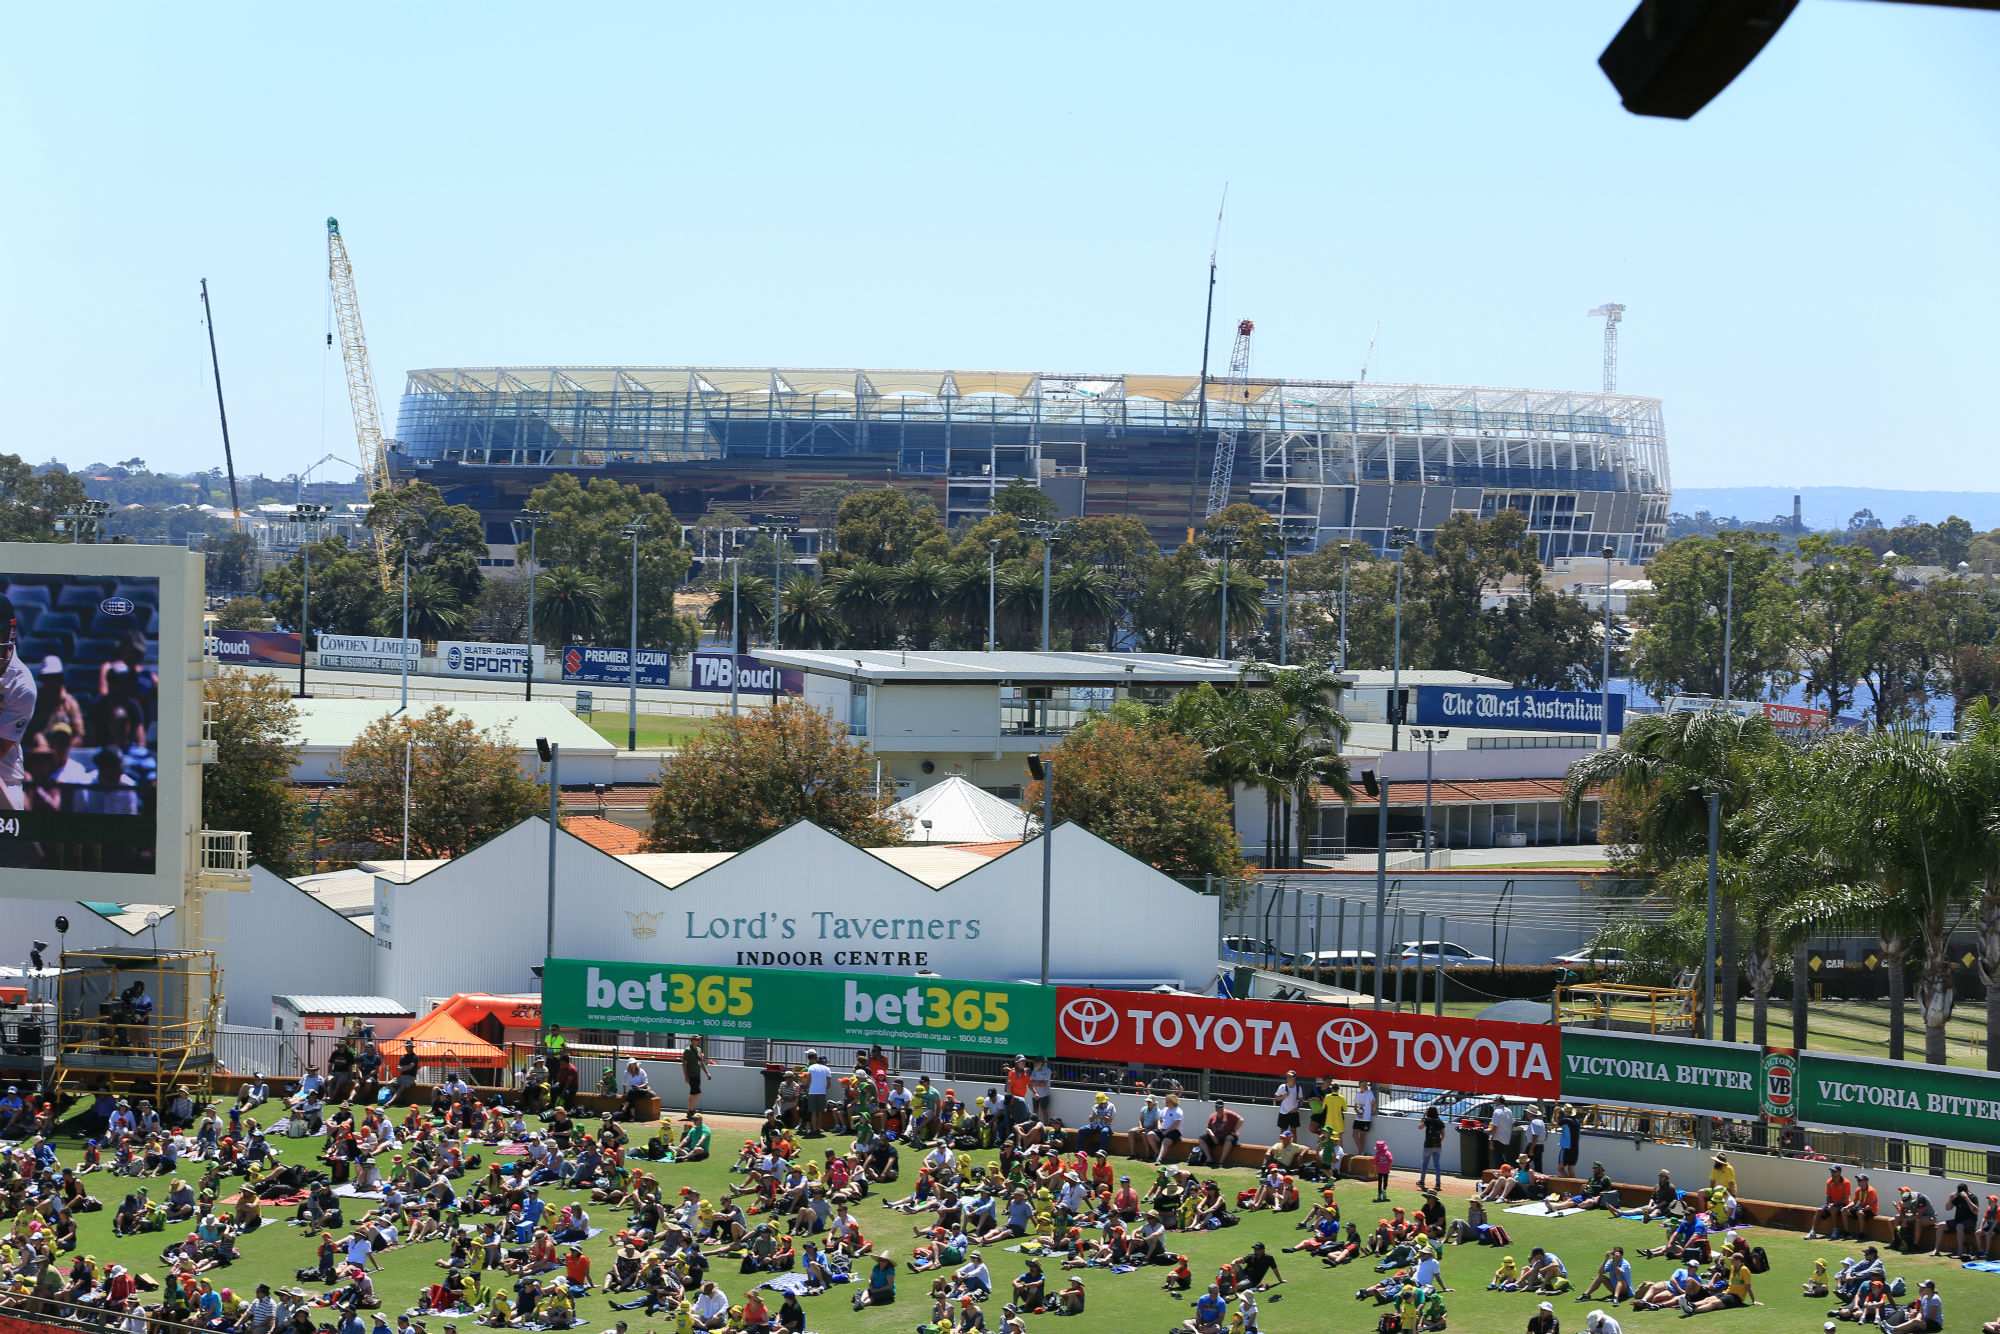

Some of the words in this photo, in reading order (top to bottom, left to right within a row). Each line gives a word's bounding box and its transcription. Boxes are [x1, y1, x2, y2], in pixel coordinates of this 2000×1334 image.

[320, 636, 368, 651] COWDEN
[585, 650, 628, 663] PREMIER
[633, 652, 668, 666] UZUKI
[464, 657, 533, 674] SPORTS
[695, 657, 781, 689] TABtouch
[1442, 692, 1473, 715] The
[1476, 693, 1521, 718] West
[1522, 695, 1604, 721] Australian
[686, 911, 796, 940] Lord's
[811, 911, 981, 940] Taverners
[736, 951, 824, 966] INDOOR
[834, 951, 929, 966] CENTRE
[586, 967, 753, 1016] bet365
[844, 980, 1010, 1033] bet365
[1128, 1009, 1300, 1058] TOYOTA
[1388, 1030, 1553, 1081] TOYOTA
[1565, 1054, 1671, 1082] VICTORIA
[1676, 1065, 1753, 1091] BITTER
[1769, 1076, 1791, 1095] VB
[1817, 1080, 1922, 1111] VICTORIA
[1926, 1093, 2000, 1121] BITTER
